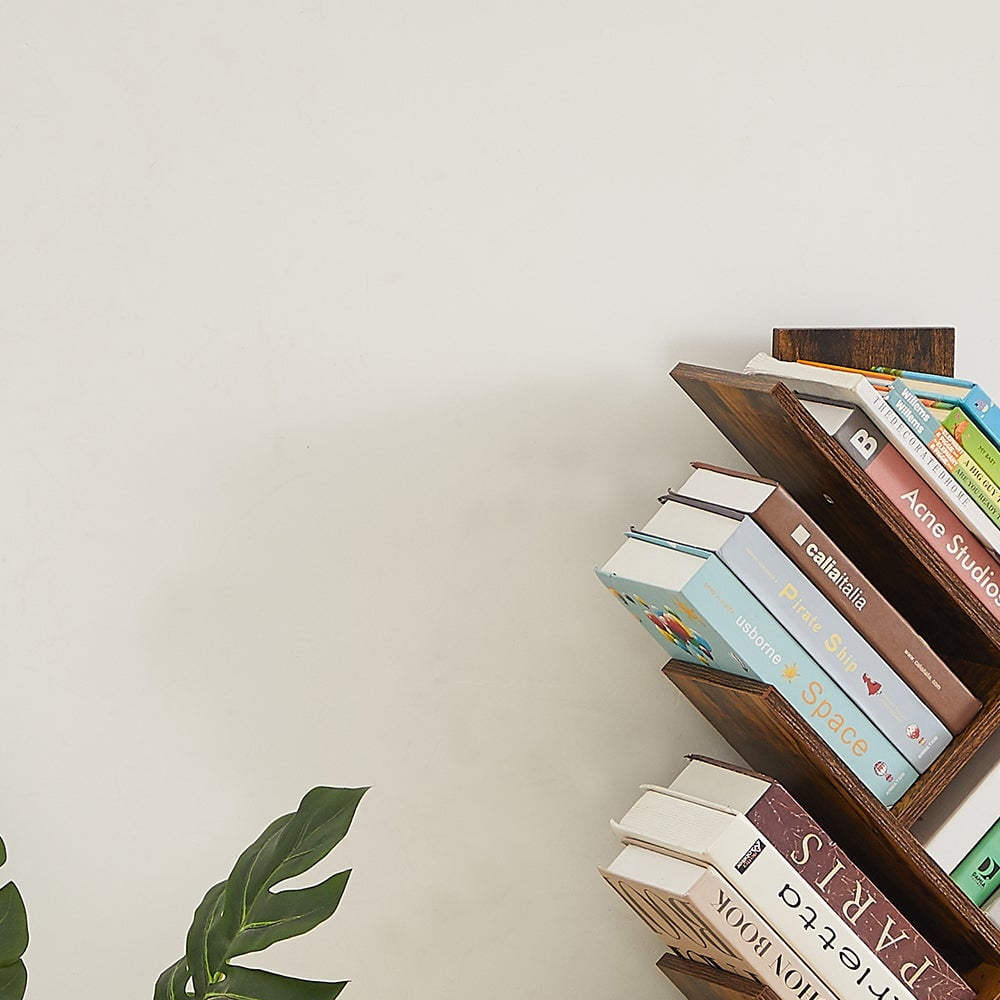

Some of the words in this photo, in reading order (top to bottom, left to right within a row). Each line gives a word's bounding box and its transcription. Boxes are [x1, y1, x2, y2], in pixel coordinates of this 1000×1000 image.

[893, 399, 926, 434] Willems
[899, 387, 932, 422] Willems
[848, 423, 880, 462] B
[977, 445, 986, 455] MY
[984, 452, 996, 466] BABY
[955, 468, 968, 482] ARE
[966, 480, 979, 495] YOU
[977, 493, 997, 515] READY
[963, 459, 970, 467] A
[968, 465, 983, 481] BIG
[981, 480, 997, 497] GUY
[899, 480, 952, 541] Acne
[803, 538, 871, 611] caliaitalia
[777, 580, 827, 635] Pirate
[821, 629, 863, 676] Ship
[734, 612, 784, 666] usborne
[794, 677, 874, 764] Space
[708, 887, 773, 958] BOOK
[787, 827, 936, 991] PARIS
